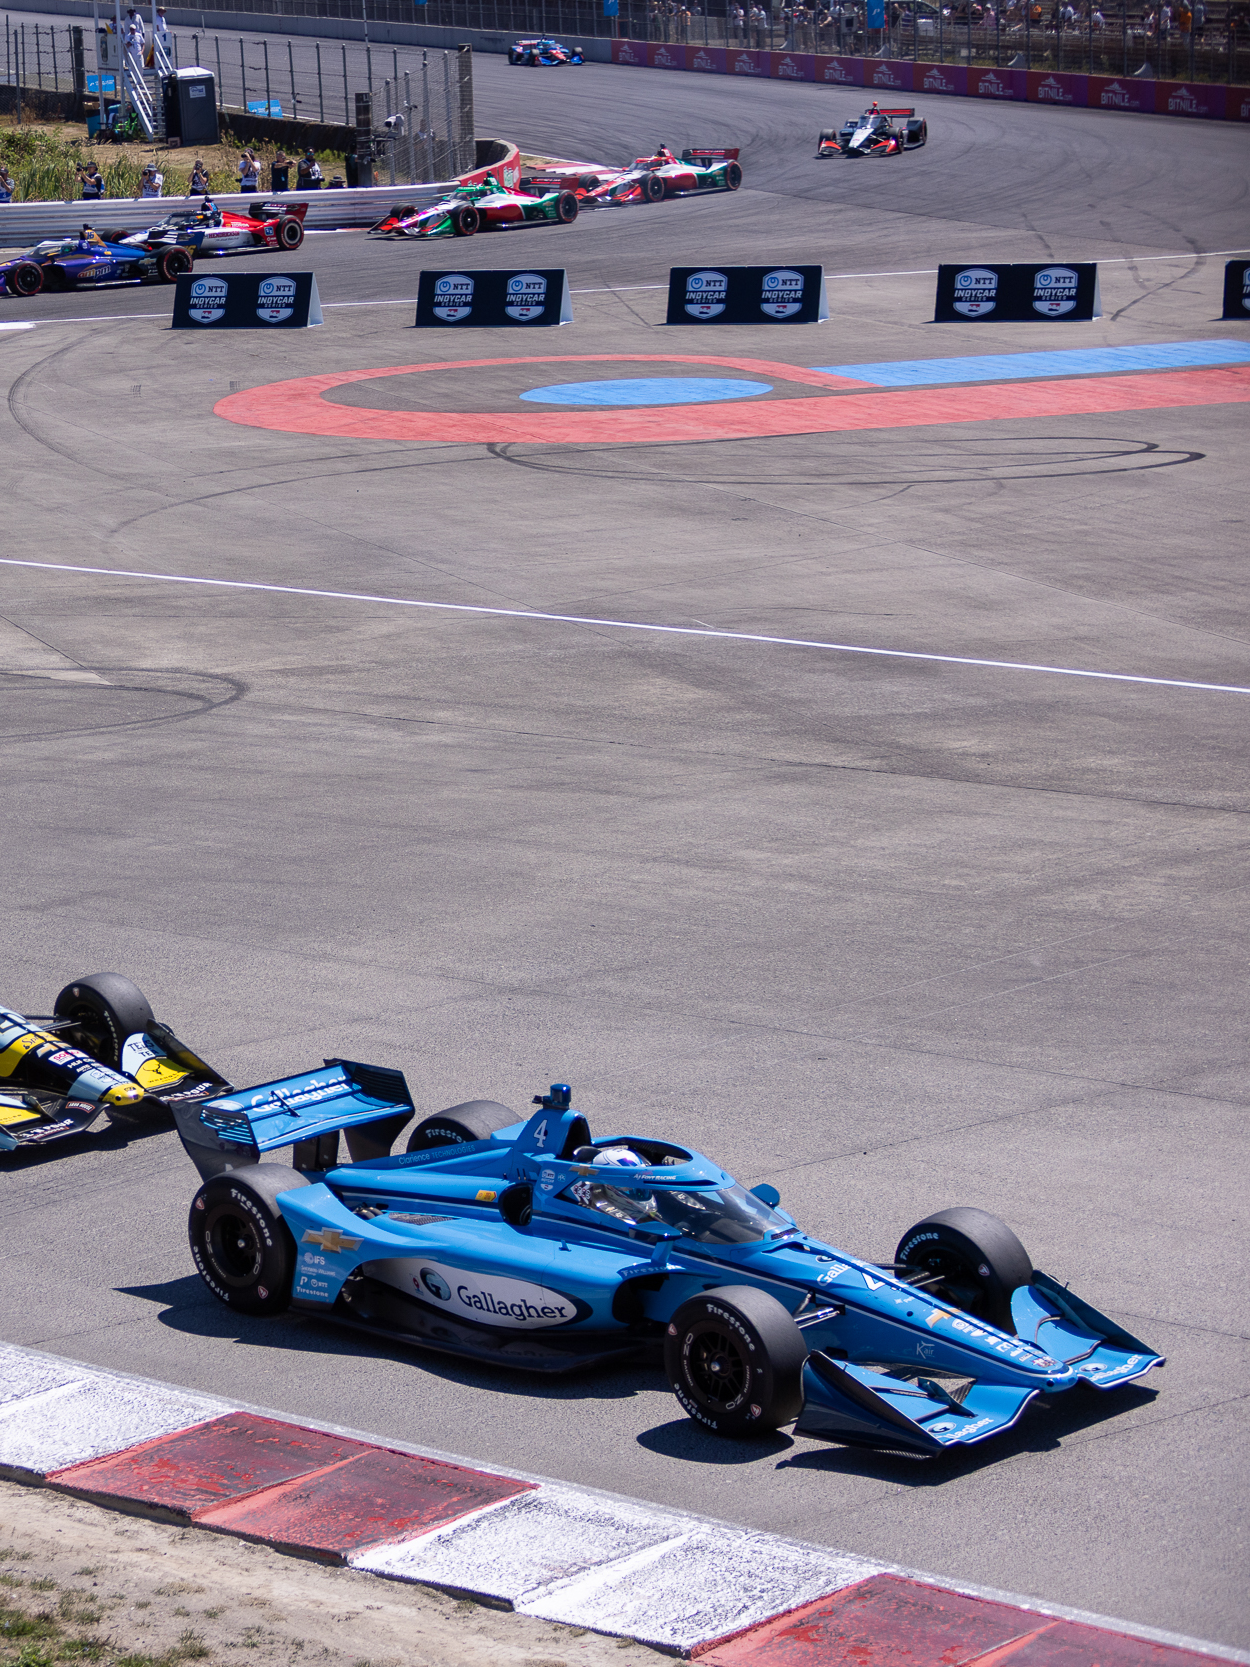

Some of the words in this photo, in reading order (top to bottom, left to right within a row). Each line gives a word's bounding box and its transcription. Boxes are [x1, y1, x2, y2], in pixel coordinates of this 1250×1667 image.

[78, 264, 112, 279] ampm
[276, 284, 292, 292] NTT
[974, 276, 994, 285] NTT
[1054, 276, 1074, 284] NTT
[954, 289, 996, 298] INDYCAR
[1034, 288, 1076, 297] INDYCAR
[103, 1010, 118, 1062] Firestone
[425, 1128, 467, 1144] Firesto
[534, 1119, 548, 1148] 4
[398, 1152, 430, 1165] Clarience
[431, 1144, 476, 1159] TECHNOLOGIES
[230, 1188, 273, 1248] Firestone
[900, 1232, 939, 1260] Firestone
[314, 1255, 326, 1266] IFS
[193, 1245, 230, 1302] Firestone
[620, 1266, 668, 1277] Firesto
[296, 1286, 329, 1298] Firestone
[457, 1285, 569, 1322] Gallagher
[706, 1303, 756, 1351] Firestone
[674, 1383, 718, 1430] Firestone
